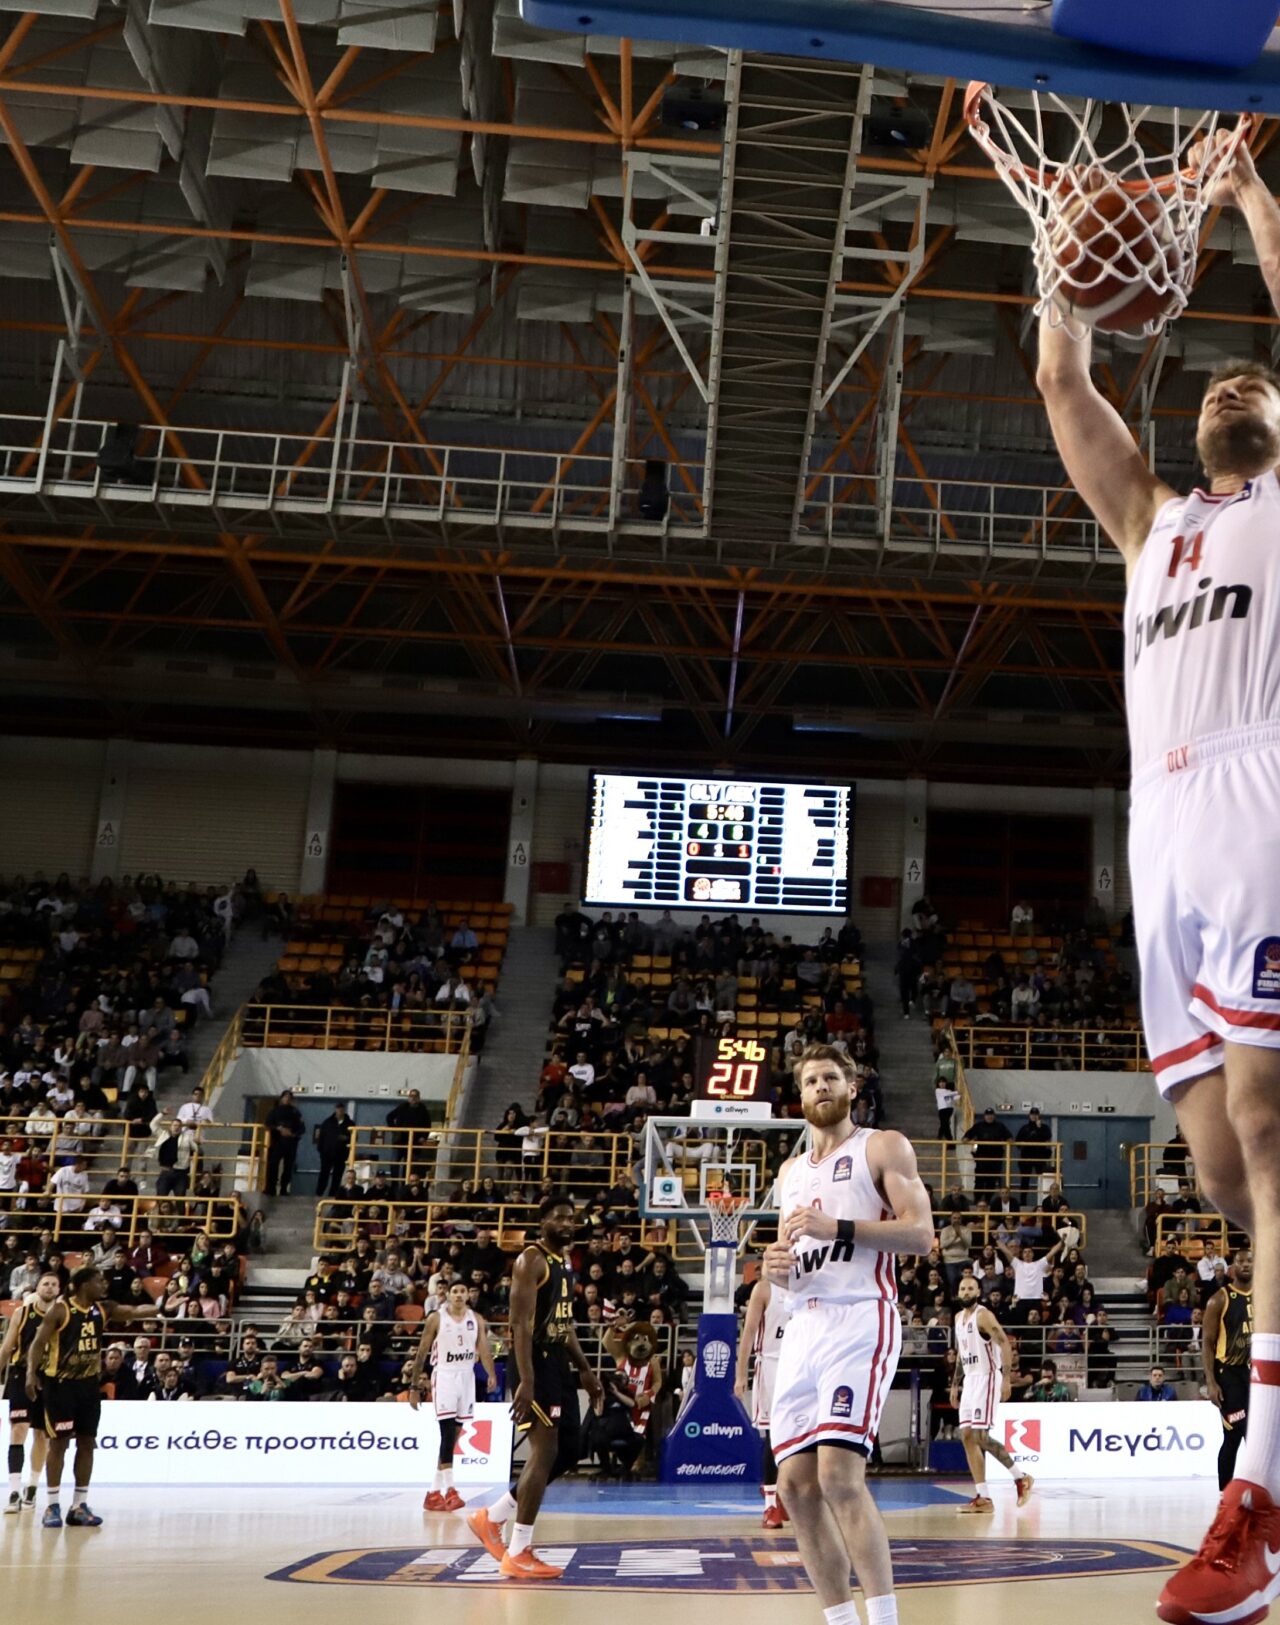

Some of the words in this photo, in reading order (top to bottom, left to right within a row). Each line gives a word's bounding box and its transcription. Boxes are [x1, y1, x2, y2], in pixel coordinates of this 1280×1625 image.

[1167, 530, 1204, 578] 14
[1166, 746, 1188, 773] OLY
[690, 784, 720, 801] OLY
[697, 823, 709, 838] 4
[99, 834, 115, 846] 20
[308, 845, 322, 857] 19
[688, 843, 699, 855] 0
[713, 844, 724, 857] 1
[739, 845, 748, 857] 1
[512, 854, 527, 865] 19
[907, 871, 921, 882] 17
[1098, 879, 1111, 889] 17
[717, 1038, 766, 1061] 5:46
[707, 1062, 759, 1095] 20
[555, 1301, 574, 1319] AEK
[81, 1321, 95, 1337] 24
[78, 1339, 97, 1351] AEK
[457, 1335, 464, 1347] 3
[446, 1350, 474, 1363] bwin
[10, 1409, 28, 1418] AVIS
[1228, 1409, 1246, 1423] AVIS
[55, 1421, 74, 1431] AVIS
[702, 1423, 743, 1439] allwyn
[125, 1434, 160, 1450] σε
[167, 1430, 238, 1451] κάθε
[245, 1430, 419, 1455] προσπάθεια
[1069, 1426, 1206, 1457] Μεγάλο
[461, 1456, 489, 1465] EKO
[1014, 1455, 1039, 1463] EKO
